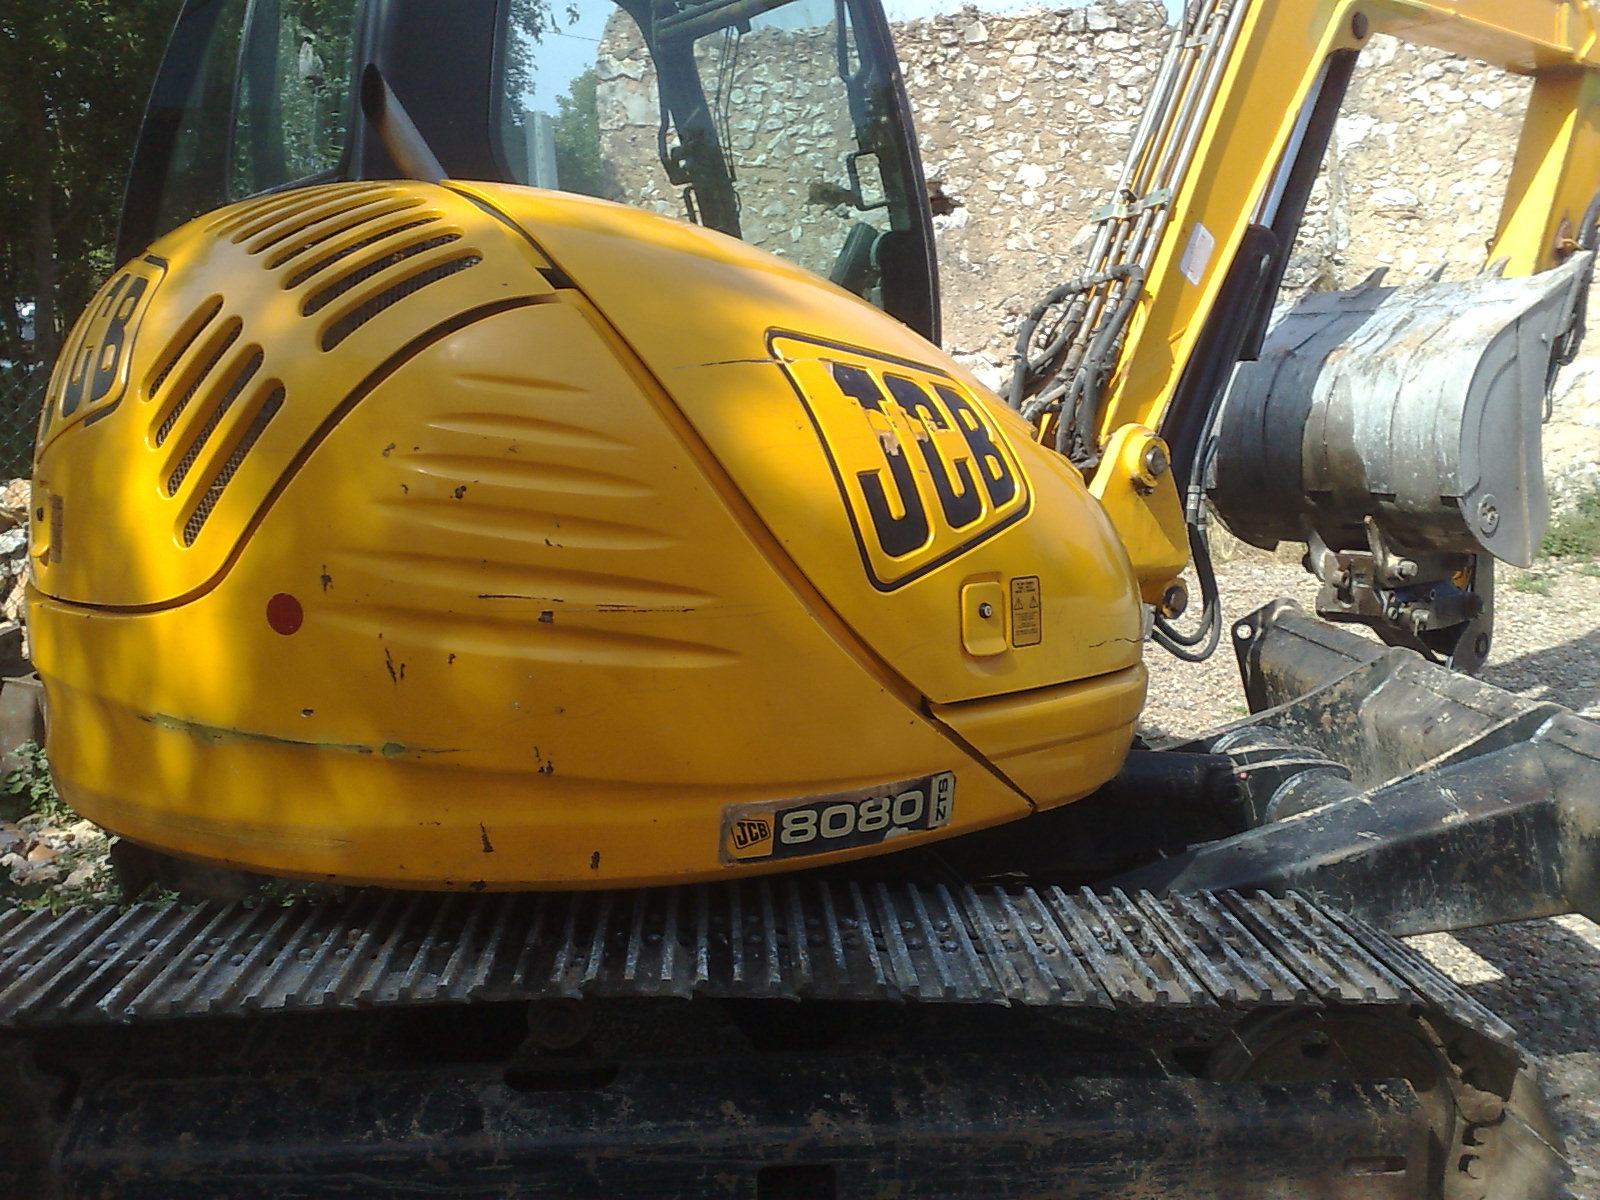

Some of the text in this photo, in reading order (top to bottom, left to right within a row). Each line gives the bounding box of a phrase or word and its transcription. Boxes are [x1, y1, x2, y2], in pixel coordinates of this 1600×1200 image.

[818, 358, 1016, 557] JCB
[736, 778, 948, 846] JCB 8080 ZTS
